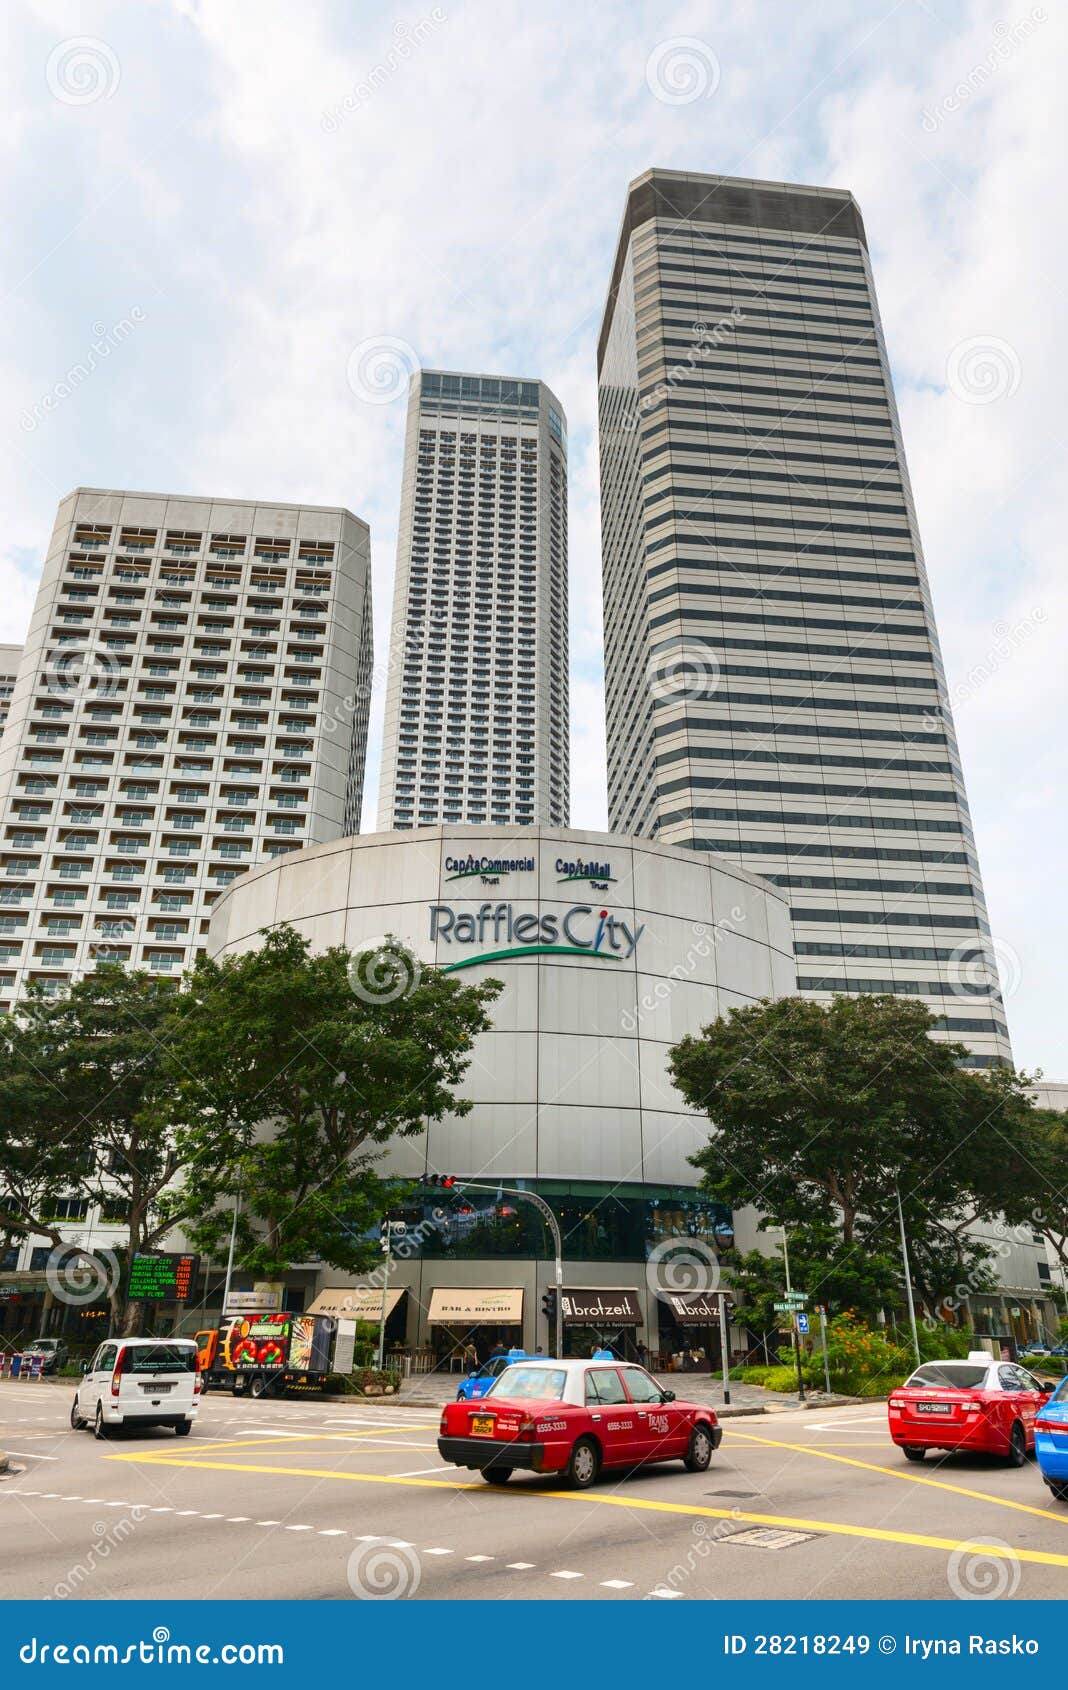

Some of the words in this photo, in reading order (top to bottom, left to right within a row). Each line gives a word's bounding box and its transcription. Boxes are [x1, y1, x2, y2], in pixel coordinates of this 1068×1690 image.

[445, 855, 535, 872] CapitaCommercial
[555, 858, 610, 877] CapitaMall
[480, 875, 500, 885] Trust
[589, 880, 609, 890] Trust
[429, 903, 559, 944] Raffles
[563, 905, 645, 959] City
[536, 1420, 567, 1433] 6555-3333
[607, 1420, 633, 1431] 6555-3333
